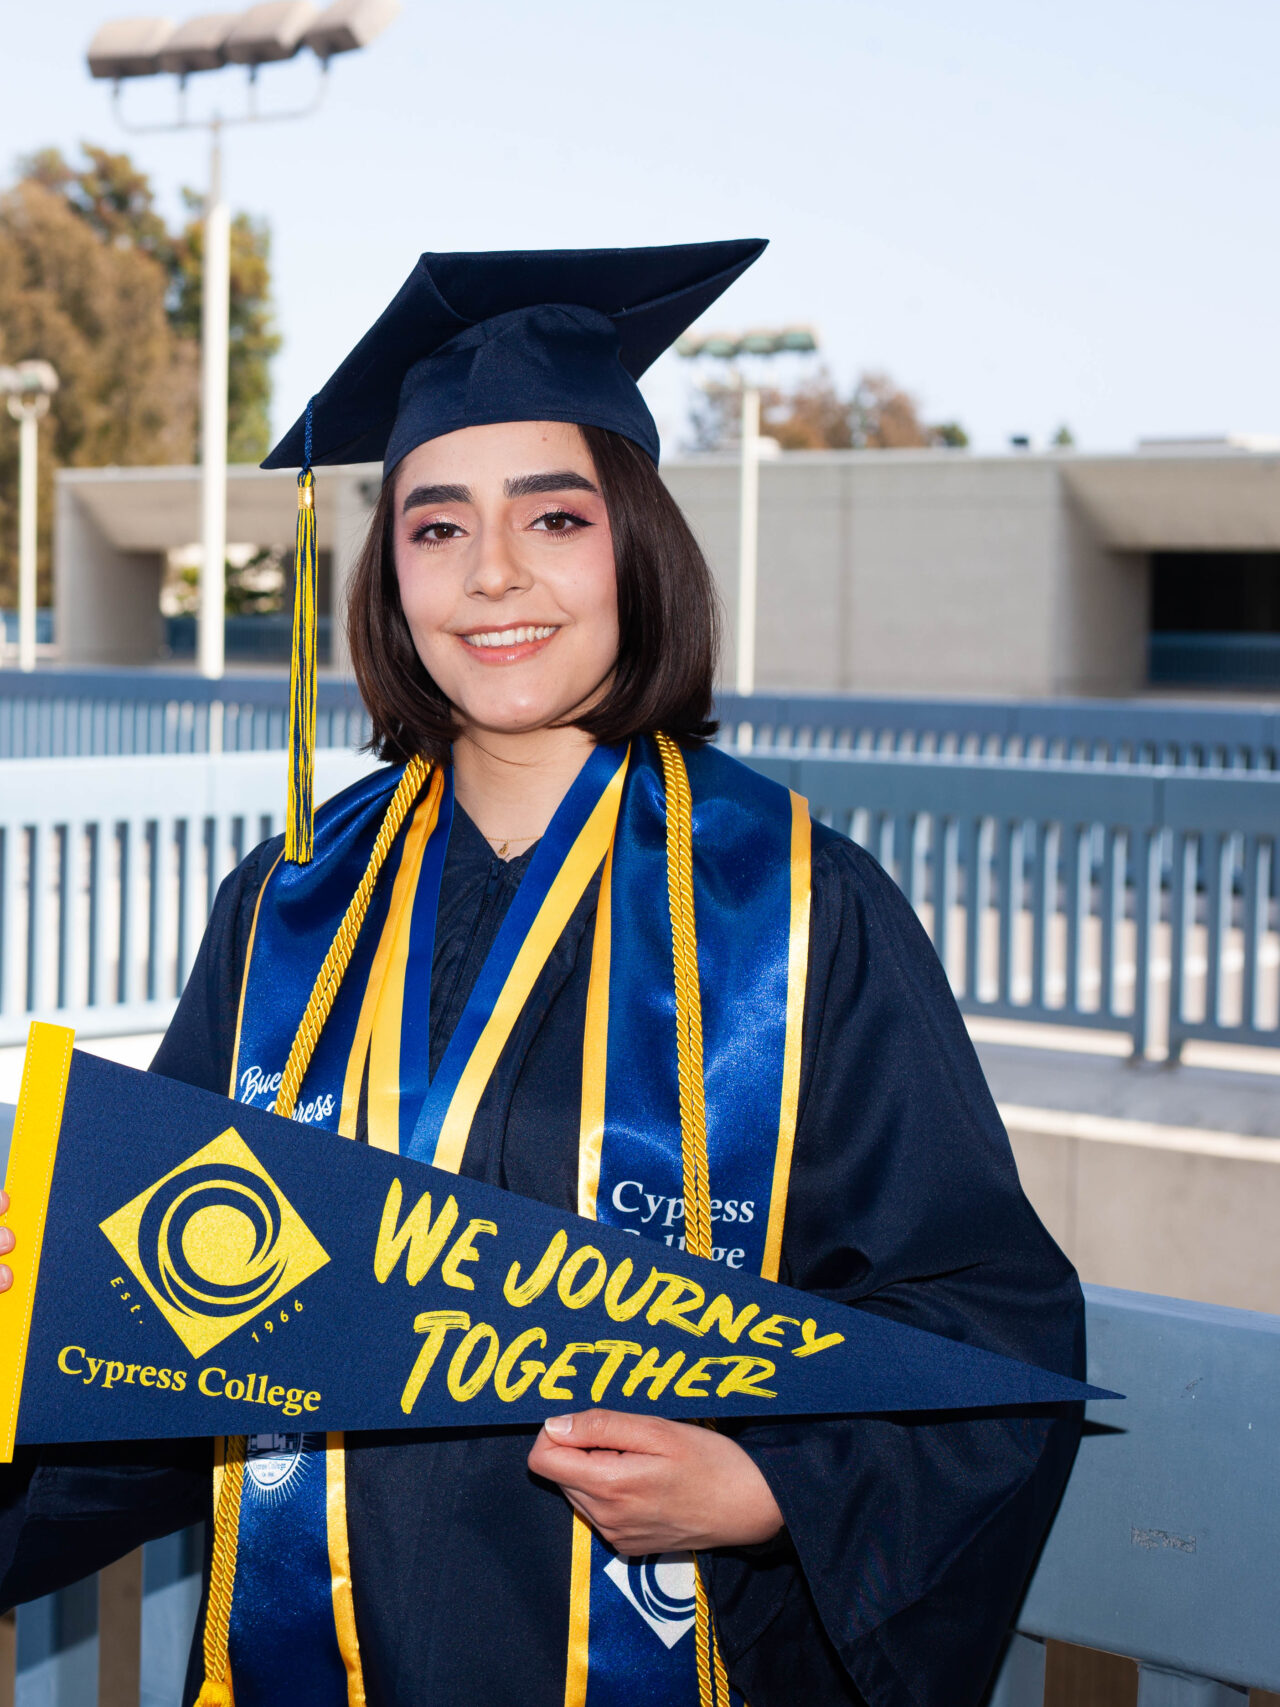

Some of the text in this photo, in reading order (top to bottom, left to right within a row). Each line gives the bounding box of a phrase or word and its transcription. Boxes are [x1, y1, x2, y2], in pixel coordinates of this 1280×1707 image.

[612, 1180, 755, 1227] Cypess
[374, 1178, 846, 1357] WE JOURNEY
[110, 1276, 143, 1324] Est.
[251, 1299, 303, 1343] 1966
[57, 1345, 321, 1416] Cypress College
[401, 1310, 778, 1414] TOGETHER
